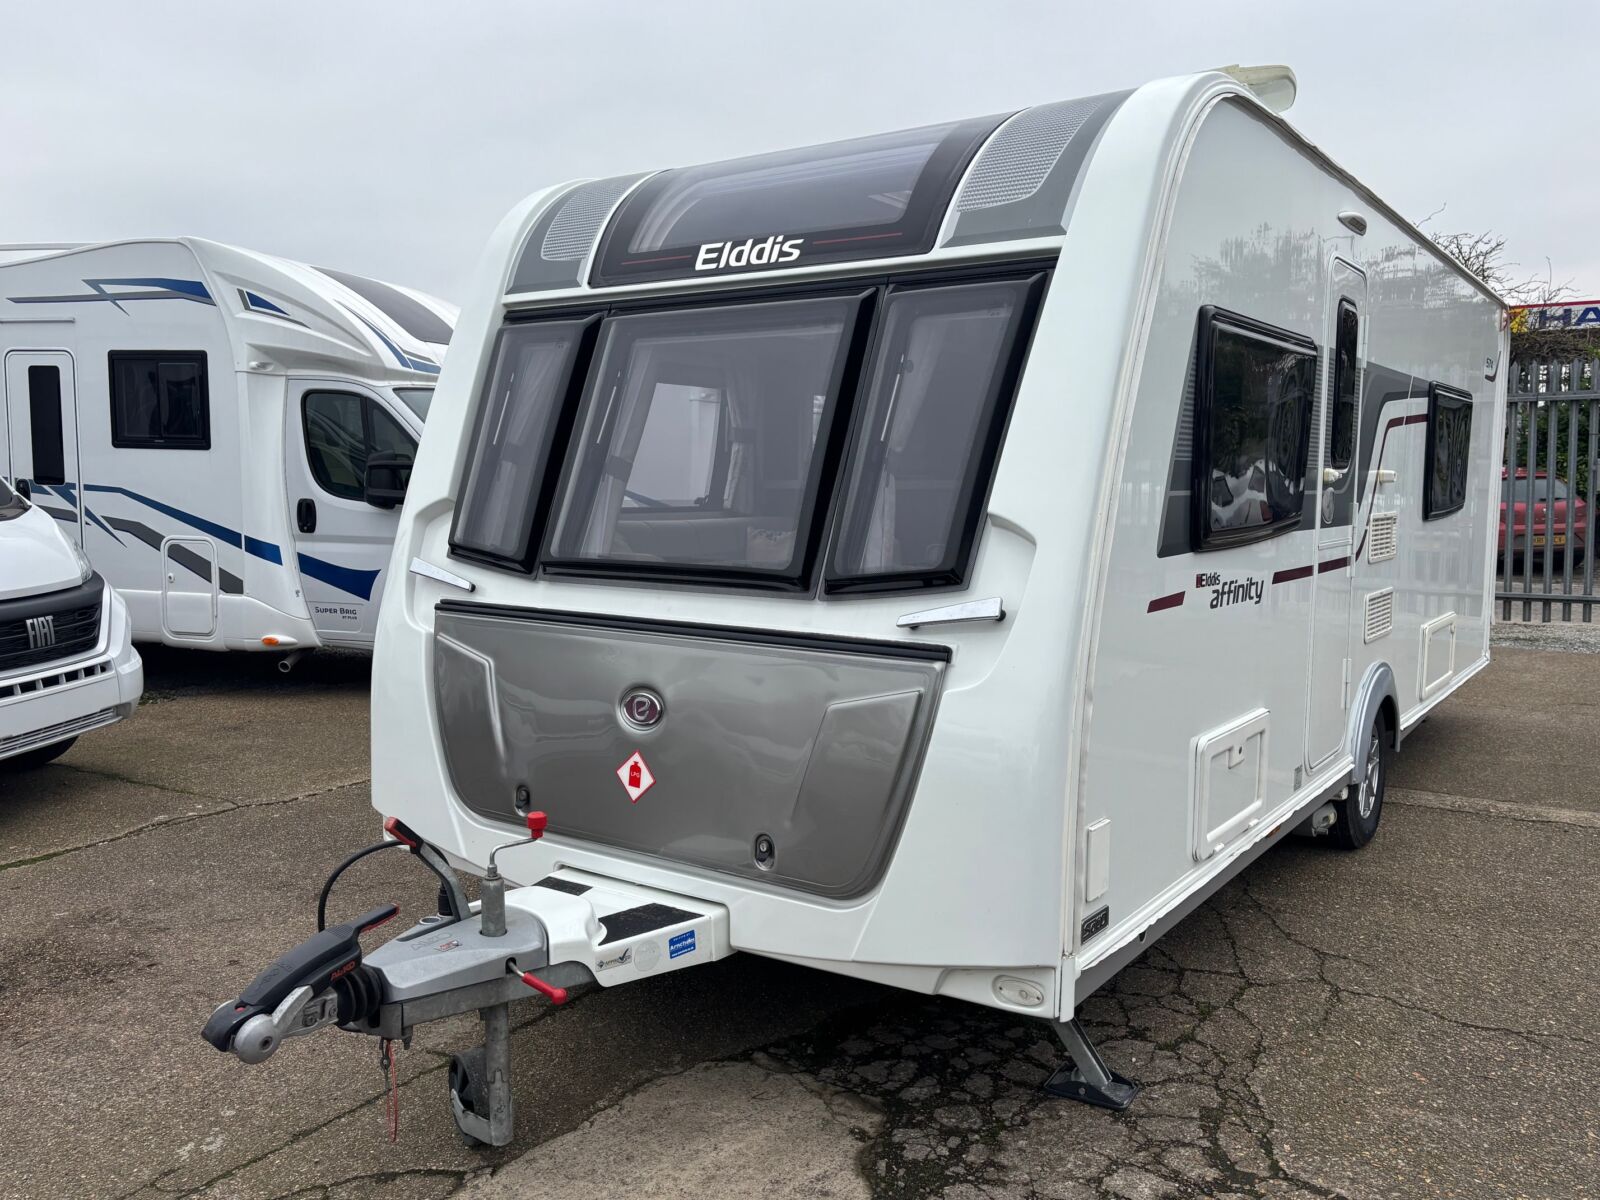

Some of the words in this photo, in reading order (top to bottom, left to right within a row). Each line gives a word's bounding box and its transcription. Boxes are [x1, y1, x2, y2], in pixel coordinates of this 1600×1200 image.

[695, 235, 804, 271] Elddis
[1200, 572, 1220, 587] Elddis
[1210, 577, 1264, 609] affinity
[26, 615, 55, 649] FIAT
